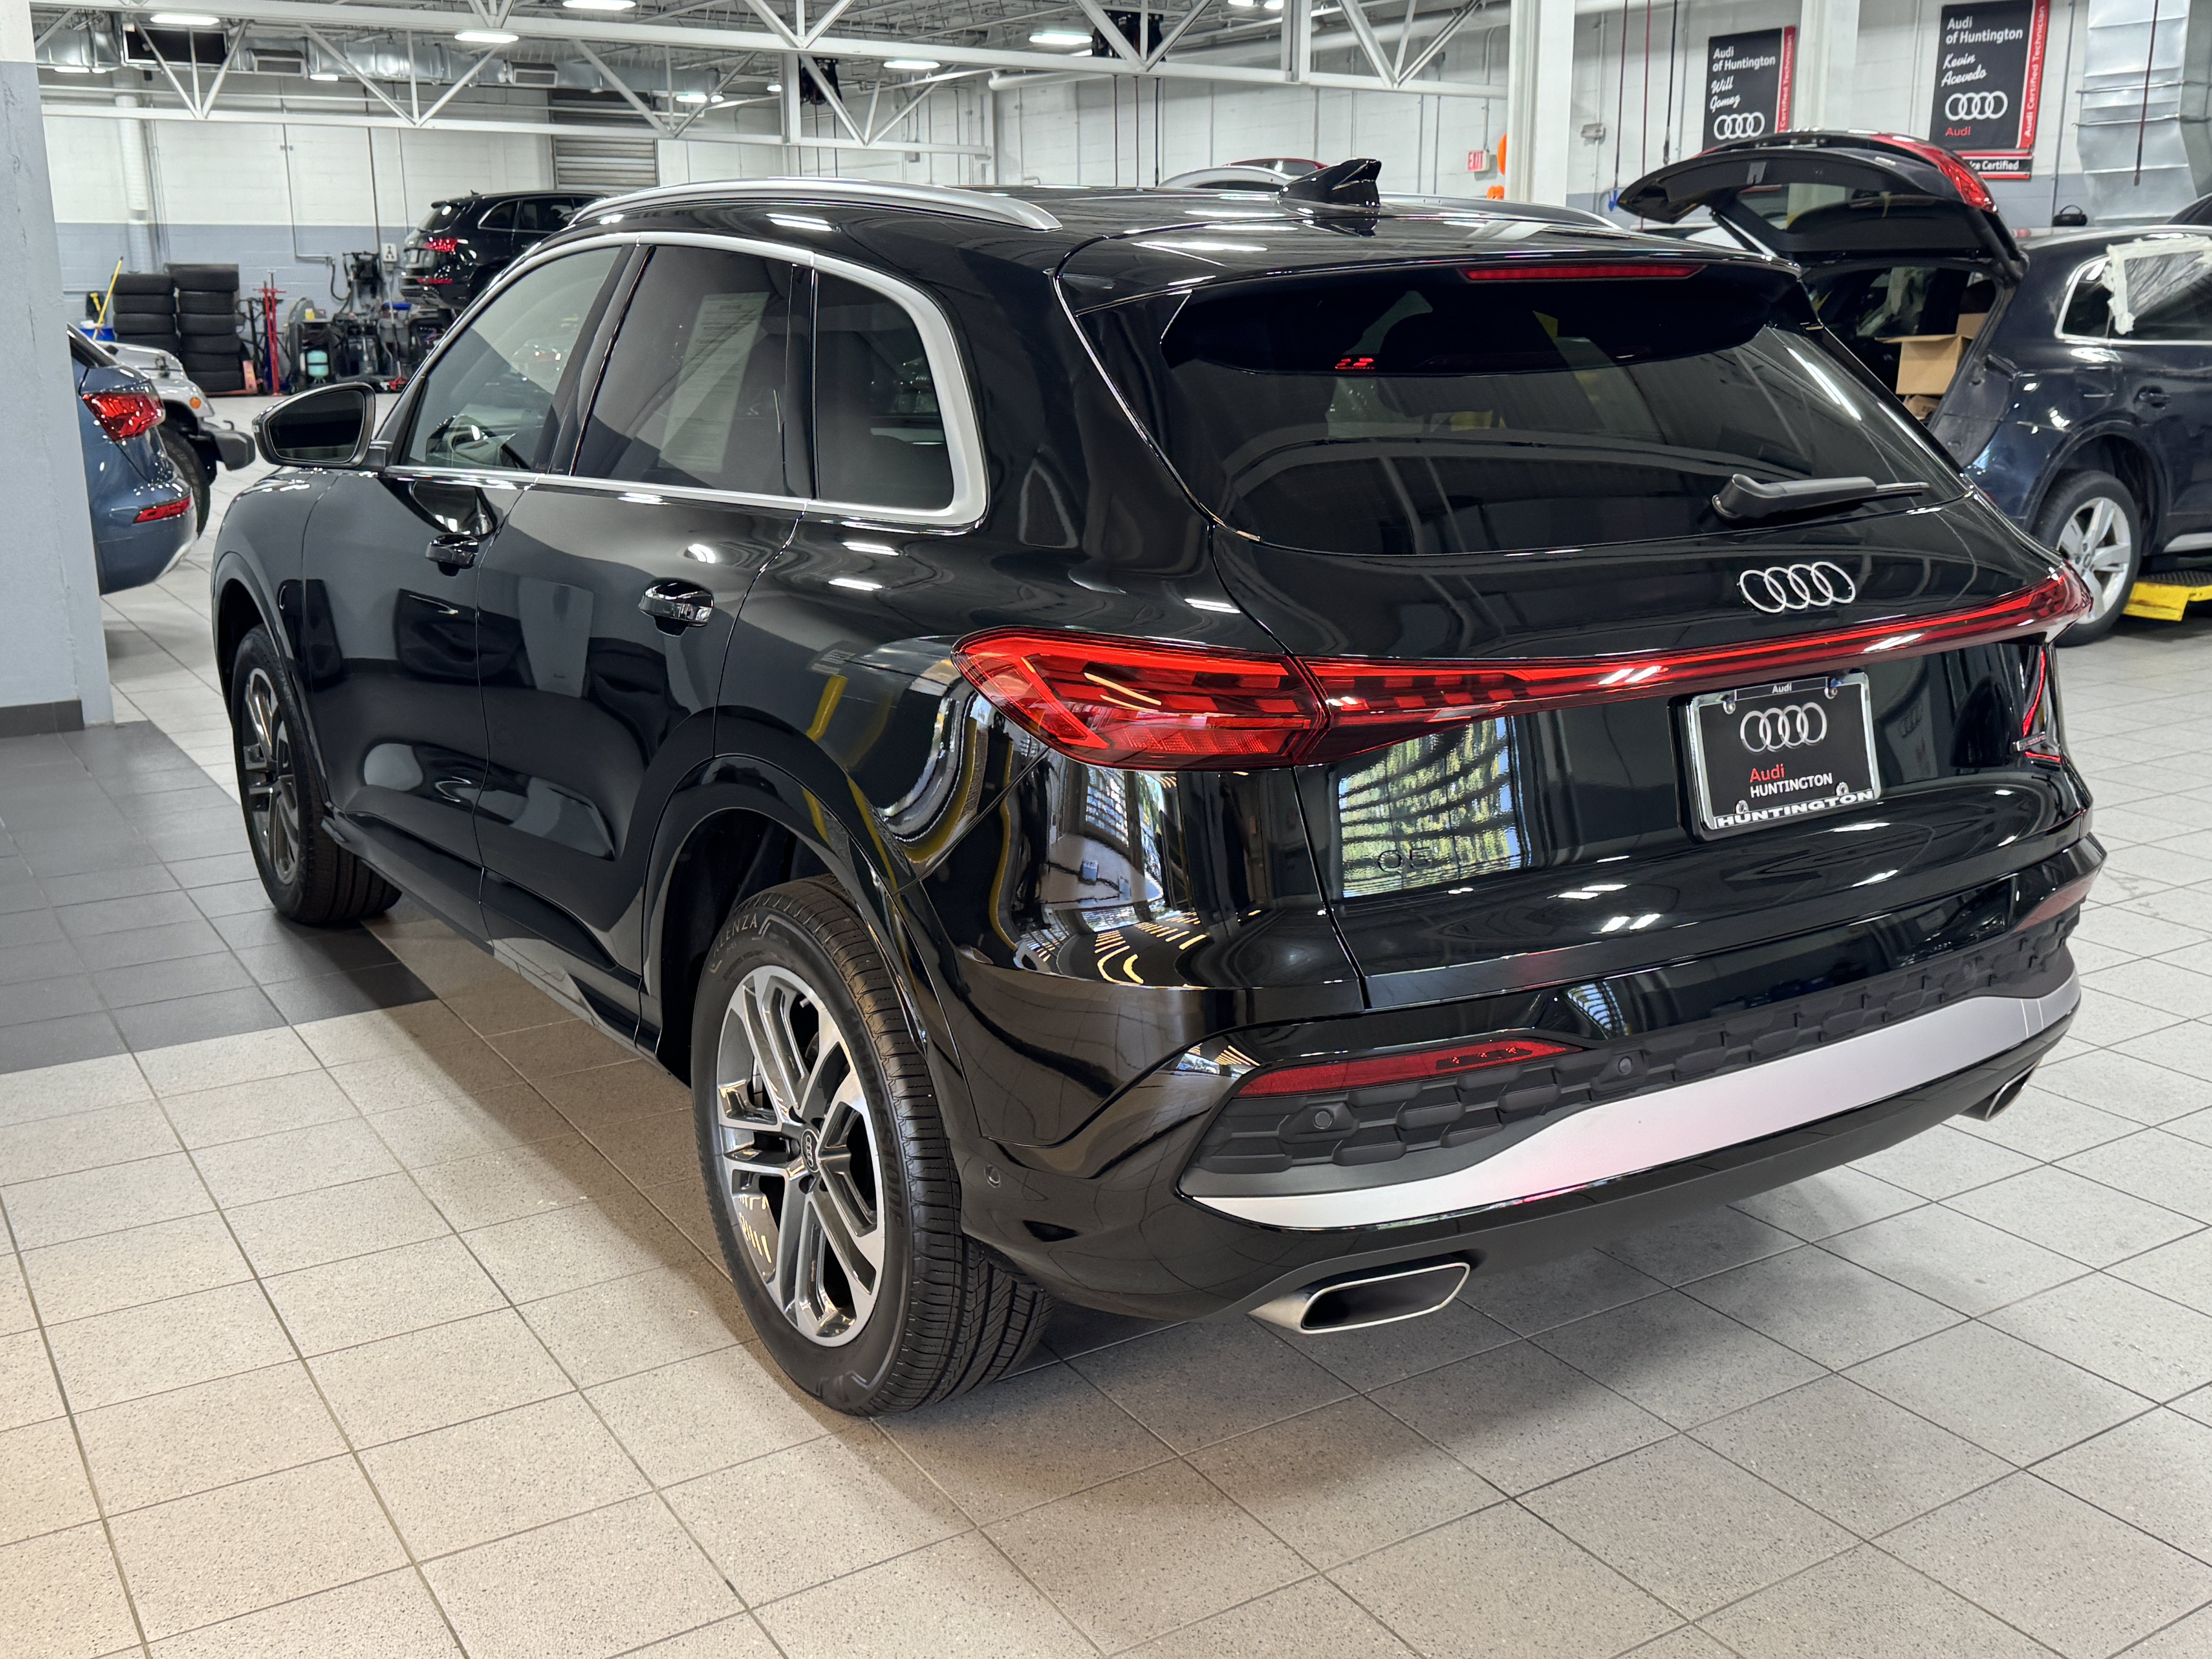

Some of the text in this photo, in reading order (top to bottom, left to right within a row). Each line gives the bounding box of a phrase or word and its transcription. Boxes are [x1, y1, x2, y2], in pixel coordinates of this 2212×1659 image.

[1947, 16, 1973, 30] Audi
[1946, 28, 2023, 44] of Huntington
[1713, 46, 1734, 59] Audi
[1942, 53, 1976, 69] Kevin
[1712, 56, 1776, 72] of Huntington
[2024, 6, 2045, 137] Audi Certified Technician
[1941, 64, 1987, 87] Acevedo
[1711, 76, 1734, 94] Will
[1945, 127, 1971, 136] Audi
[1468, 151, 1484, 170] EXIT
[1982, 160, 2019, 170] Certified
[1772, 683, 1792, 694] Audi
[1750, 764, 1785, 783] Audi
[1750, 773, 1833, 798] HUNTINGTON
[1717, 790, 1874, 828] HUNTINGTON
[1377, 847, 1432, 878] Q5
